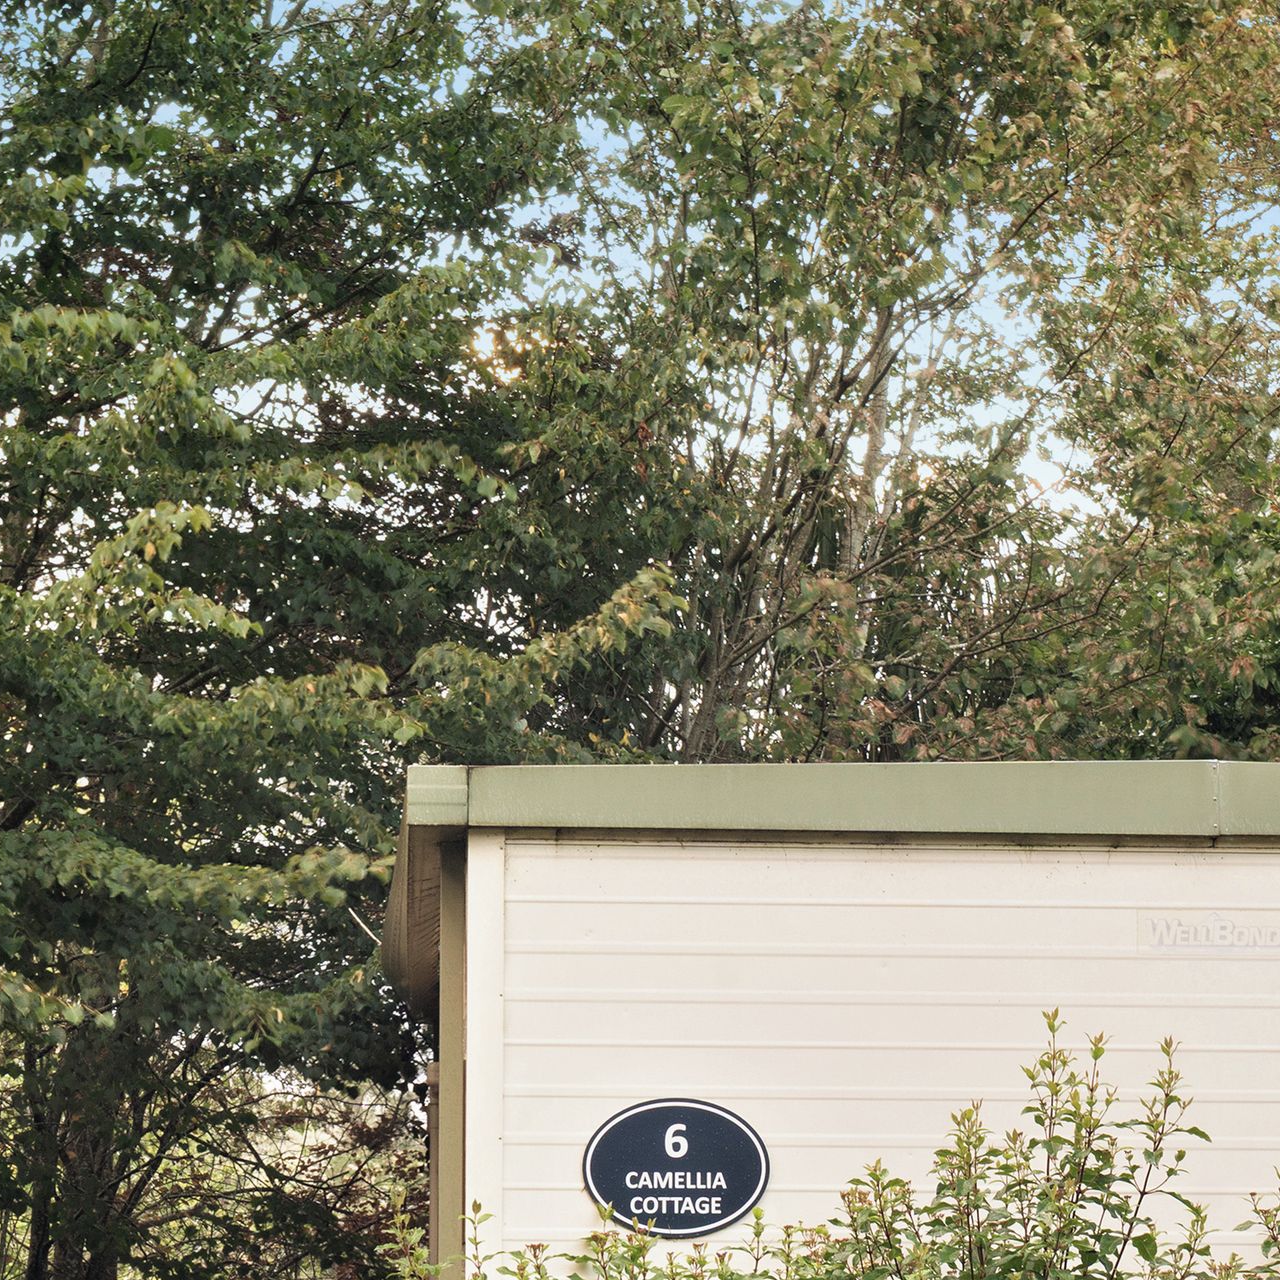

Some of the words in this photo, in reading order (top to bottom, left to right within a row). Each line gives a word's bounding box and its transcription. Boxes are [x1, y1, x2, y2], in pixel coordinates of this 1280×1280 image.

[664, 1123, 689, 1159] 6
[625, 1171, 727, 1189] CAMELLIA
[629, 1196, 722, 1215] COTTAGE
